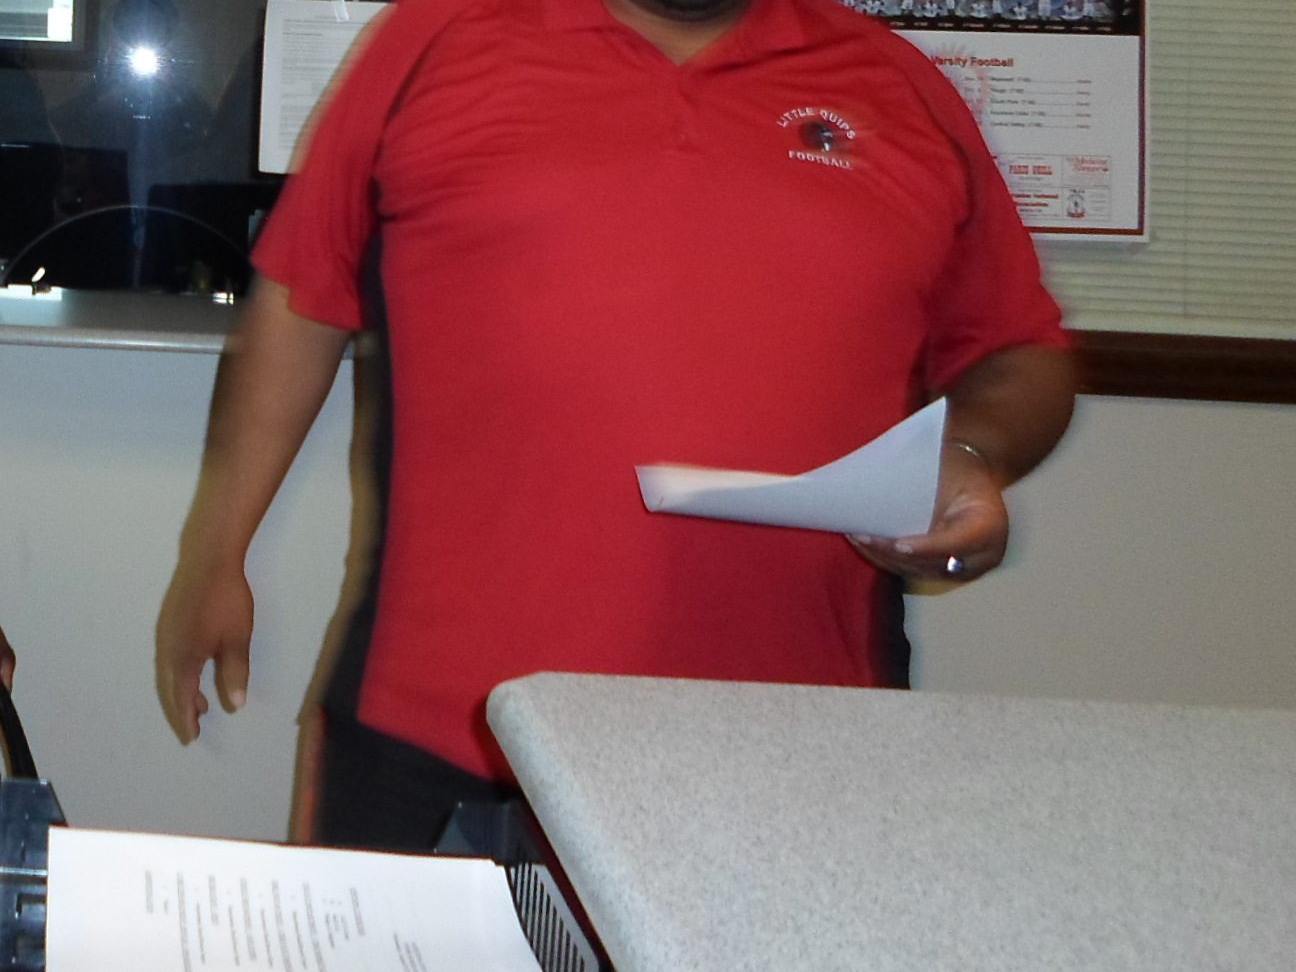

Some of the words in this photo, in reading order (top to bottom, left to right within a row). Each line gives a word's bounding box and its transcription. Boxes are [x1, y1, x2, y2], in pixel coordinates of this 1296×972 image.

[931, 55, 967, 68] Varsity
[970, 56, 1014, 68] Football
[776, 107, 815, 128] LITTLE
[819, 109, 856, 139] QUIPS
[788, 150, 853, 170] FOOTBALL
